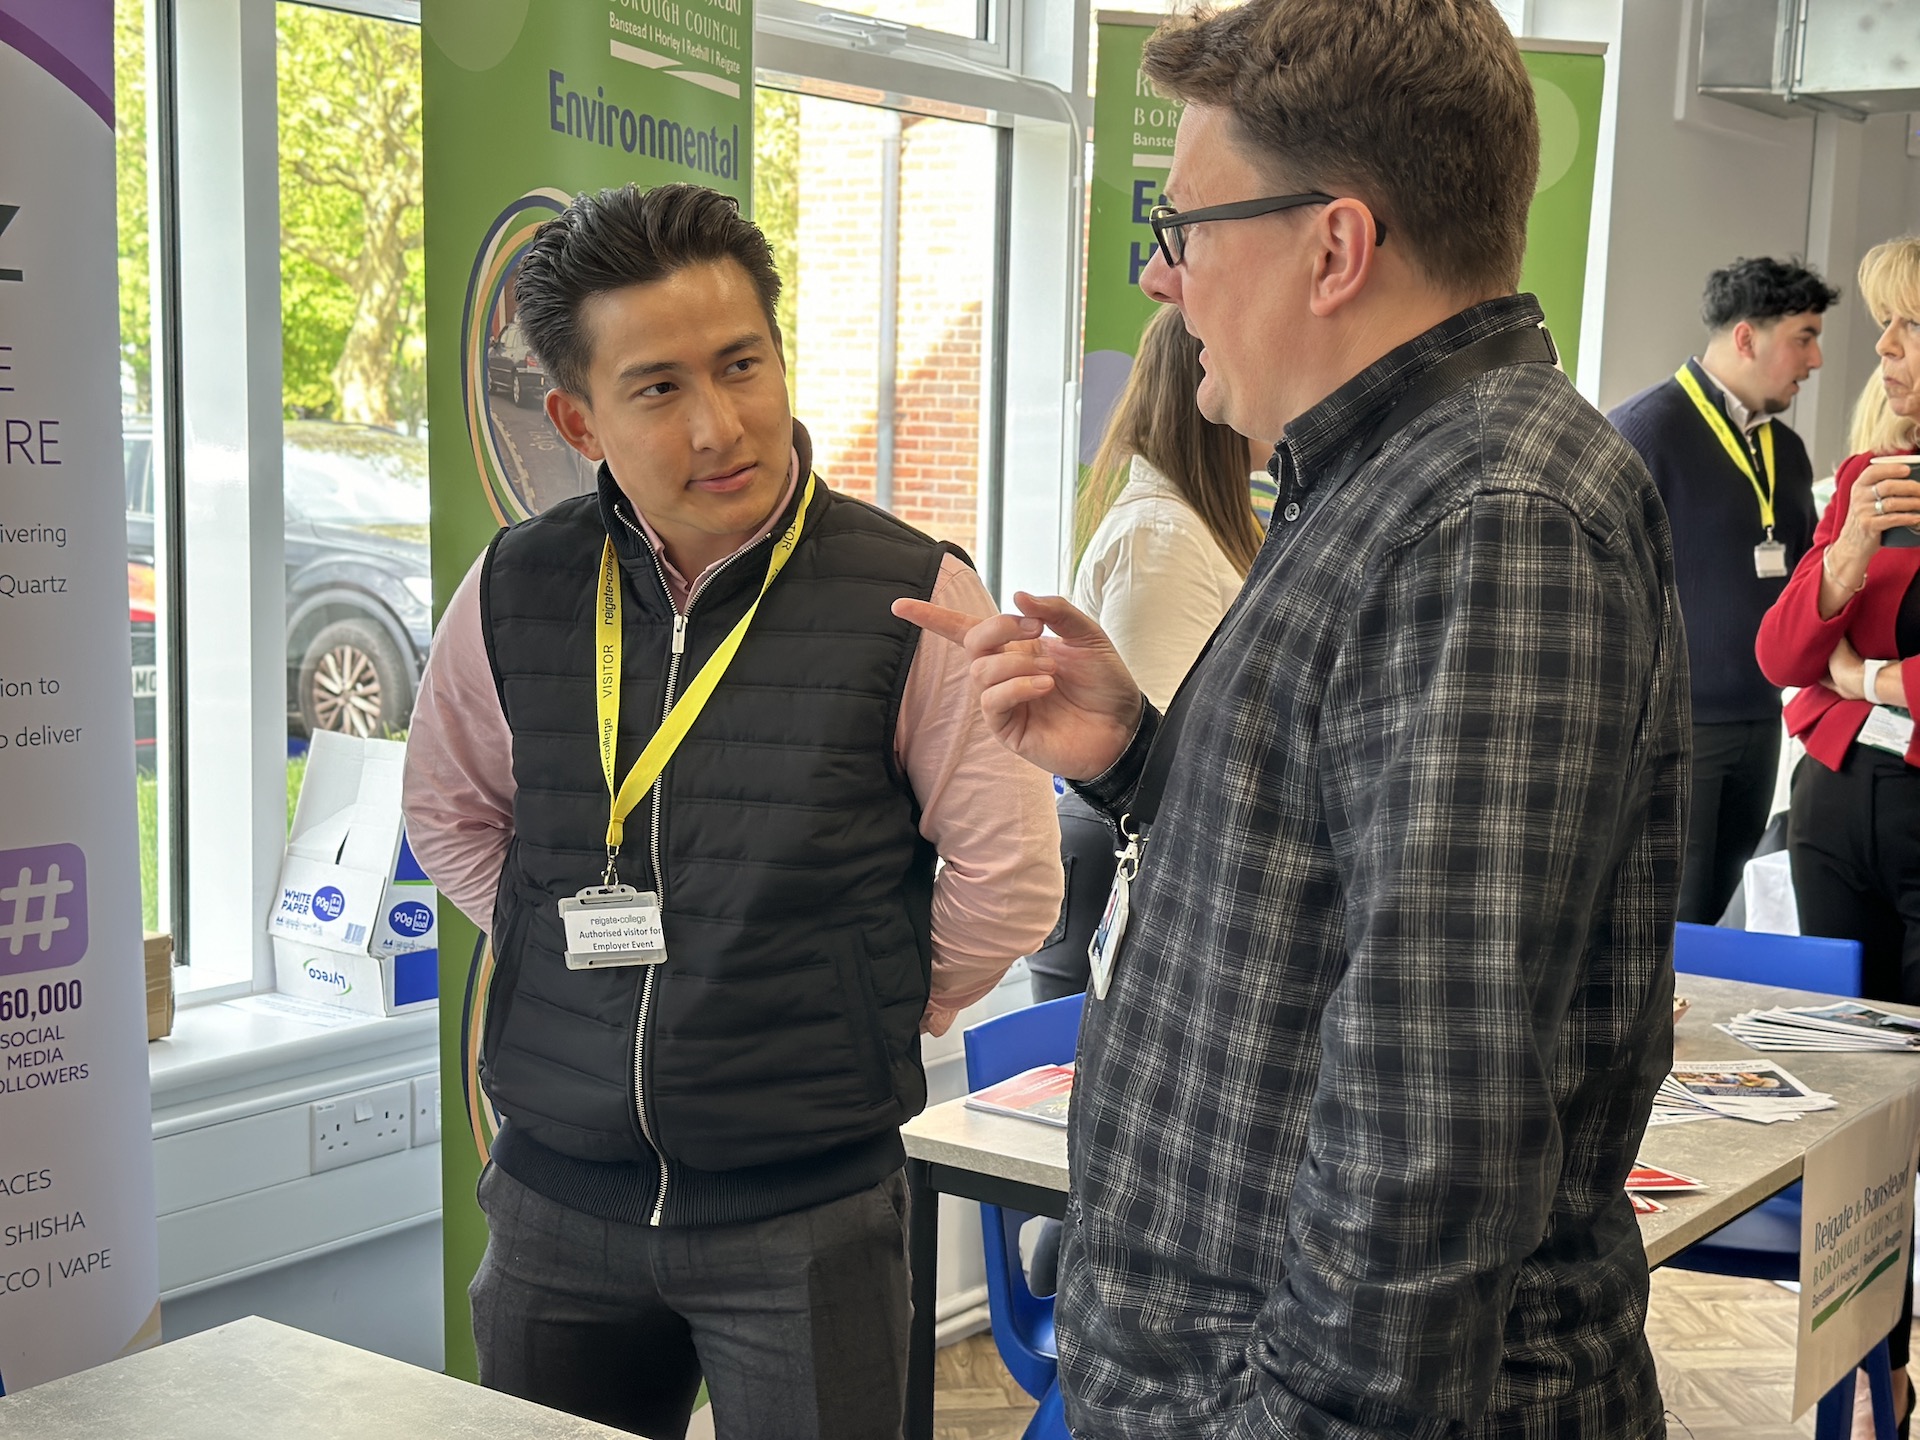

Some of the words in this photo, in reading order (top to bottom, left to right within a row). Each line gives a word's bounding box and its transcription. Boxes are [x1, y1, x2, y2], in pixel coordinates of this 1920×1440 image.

[685, 9, 740, 50] COUNCIL
[609, 11, 647, 39] Banstead
[655, 28, 681, 55] Horley
[715, 51, 740, 75] Reigate
[549, 69, 738, 181] Environmental
[1133, 132, 1176, 147] Banste
[0, 574, 67, 598] Quartz
[603, 645, 614, 698] VISITOR
[39, 677, 60, 695] to
[15, 725, 82, 747] deliver
[281, 900, 309, 915] PAPER
[285, 889, 312, 904] WHITE
[394, 911, 413, 927] 90g
[579, 928, 622, 939] Authorised
[623, 926, 648, 936] visitor
[650, 926, 661, 935] for
[593, 942, 630, 951] Employer
[632, 941, 654, 949] Event
[0, 1025, 65, 1049] SOCIAL
[8, 1047, 64, 1071] MEDIA
[1815, 1205, 1853, 1254] Reigate
[1854, 1200, 1863, 1224] &
[1864, 1162, 1910, 1217] Banstead
[5, 1211, 86, 1247] SHISHA
[58, 1248, 112, 1279] VAPE
[1813, 1234, 1860, 1286] BOROUGH
